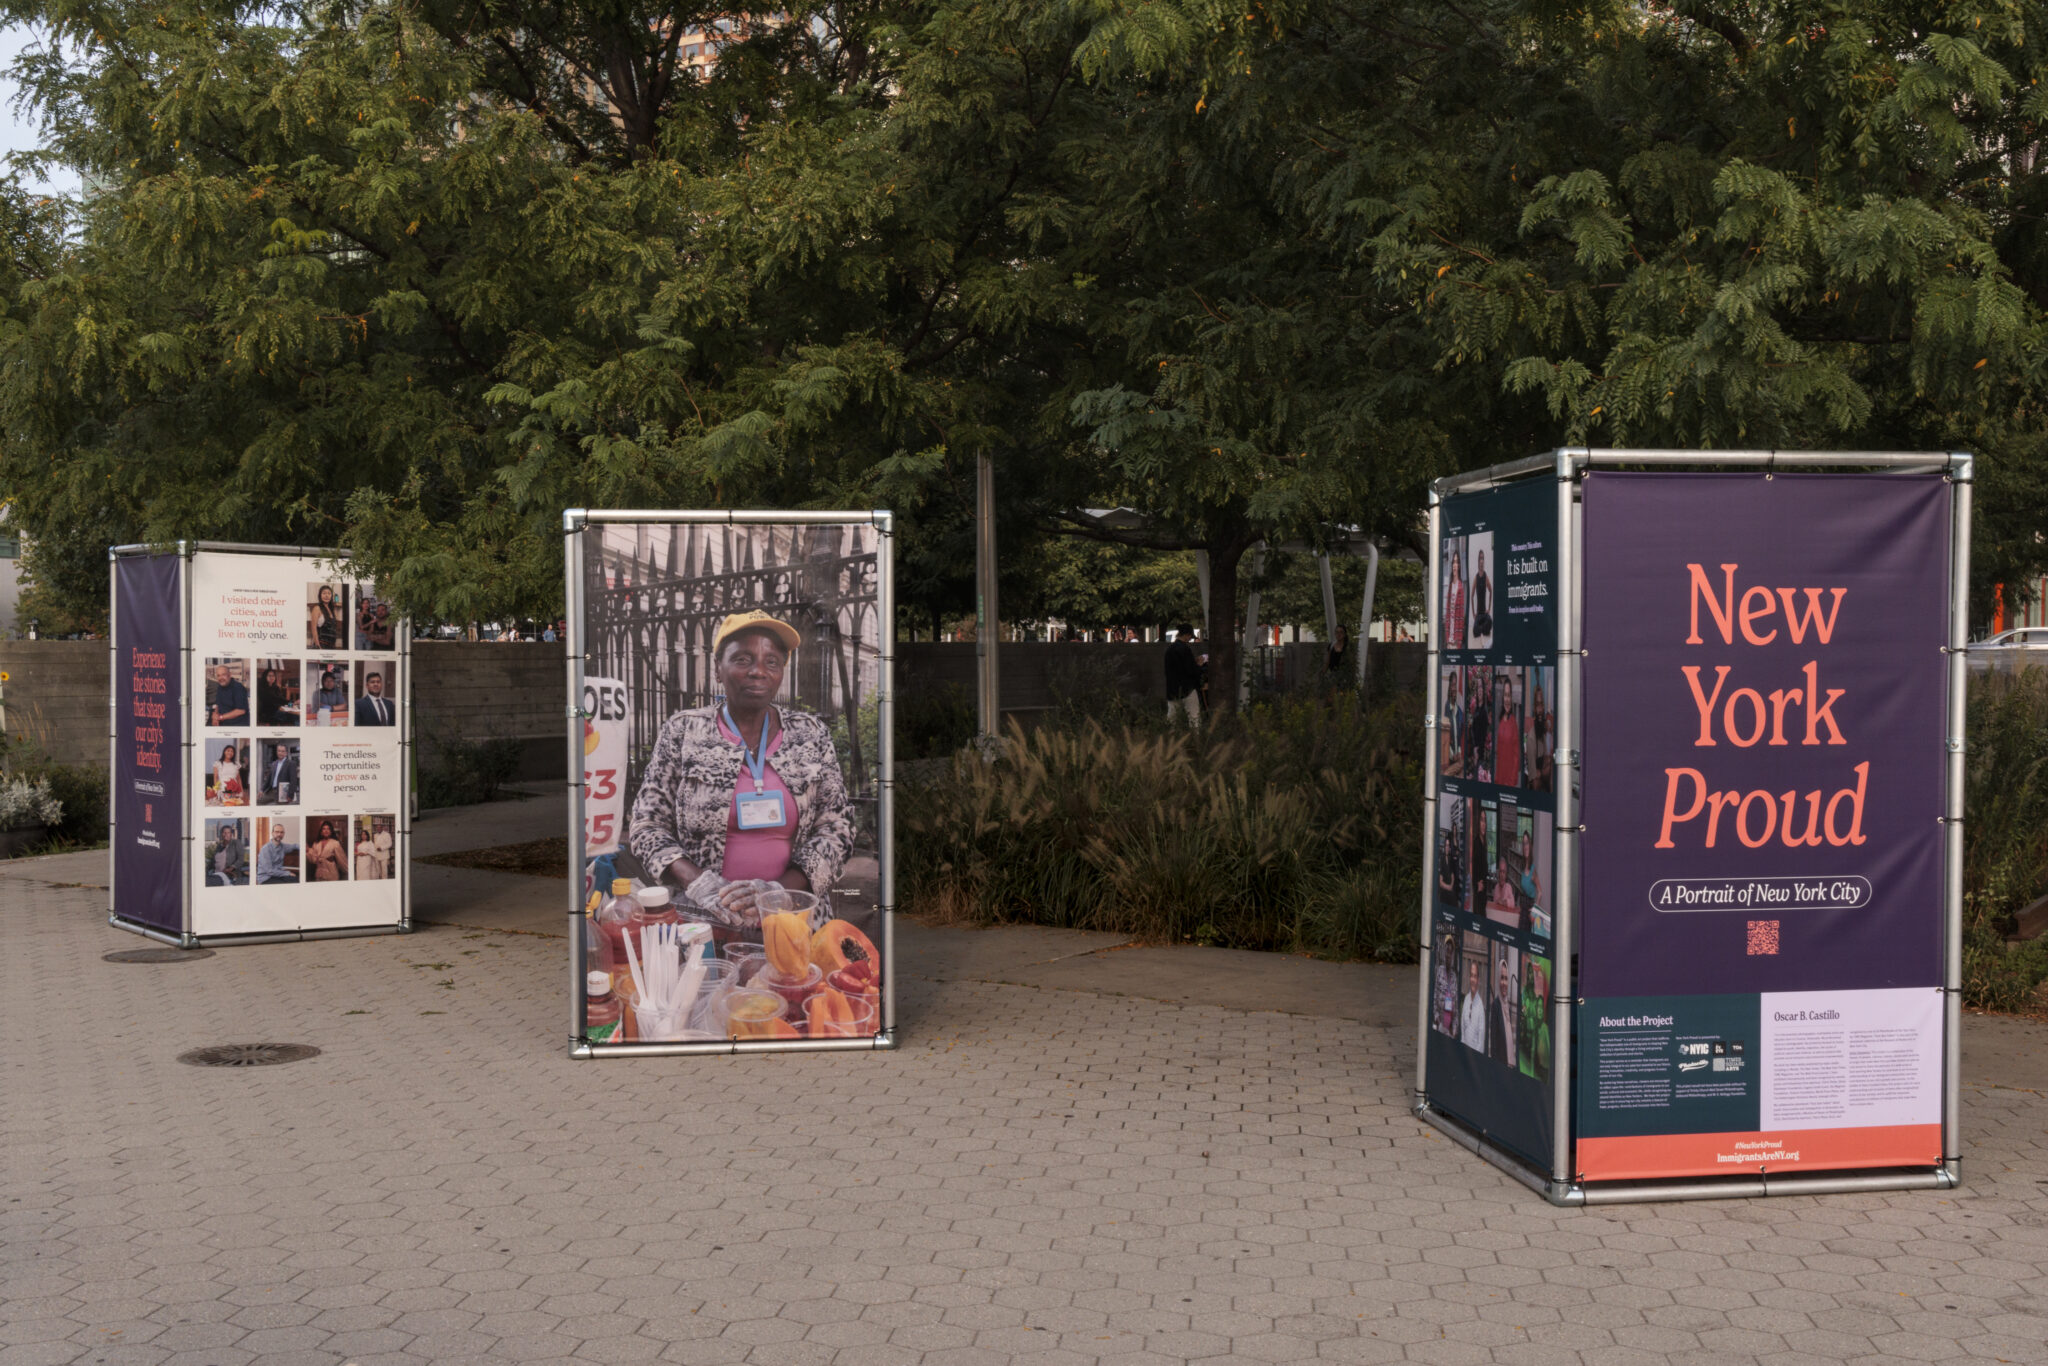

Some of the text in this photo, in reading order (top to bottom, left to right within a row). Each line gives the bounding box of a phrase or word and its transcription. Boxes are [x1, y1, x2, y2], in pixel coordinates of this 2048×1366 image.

[1507, 556, 1548, 576] It is built on
[1507, 581, 1549, 601] immigrants.
[227, 595, 259, 605] visited
[260, 596, 287, 606] other
[1685, 563, 1848, 646] New
[230, 607, 277, 617] cities, and
[224, 618, 250, 627] knew
[257, 619, 283, 628] could
[218, 629, 289, 640] live in only one.
[132, 647, 166, 672] Experience
[133, 671, 166, 694] the stories
[133, 695, 166, 722] that shape
[584, 685, 626, 721] OES
[1680, 660, 1847, 748] York
[135, 726, 146, 742] our
[323, 750, 377, 759] The endless
[319, 761, 381, 771] opportunities
[335, 774, 358, 783] grow
[333, 785, 367, 793] person.
[1654, 760, 1870, 848] Proud
[1660, 881, 1861, 906] A Portrait of New York City
[1599, 1014, 1674, 1028] About the Project
[1774, 1009, 1840, 1022] Oscar B. Castillo
[1689, 1043, 1710, 1055] NYIC
[1735, 1140, 1783, 1149] #NewYorkProud
[1717, 1150, 1800, 1163] ImmigrantsAreNY.org
